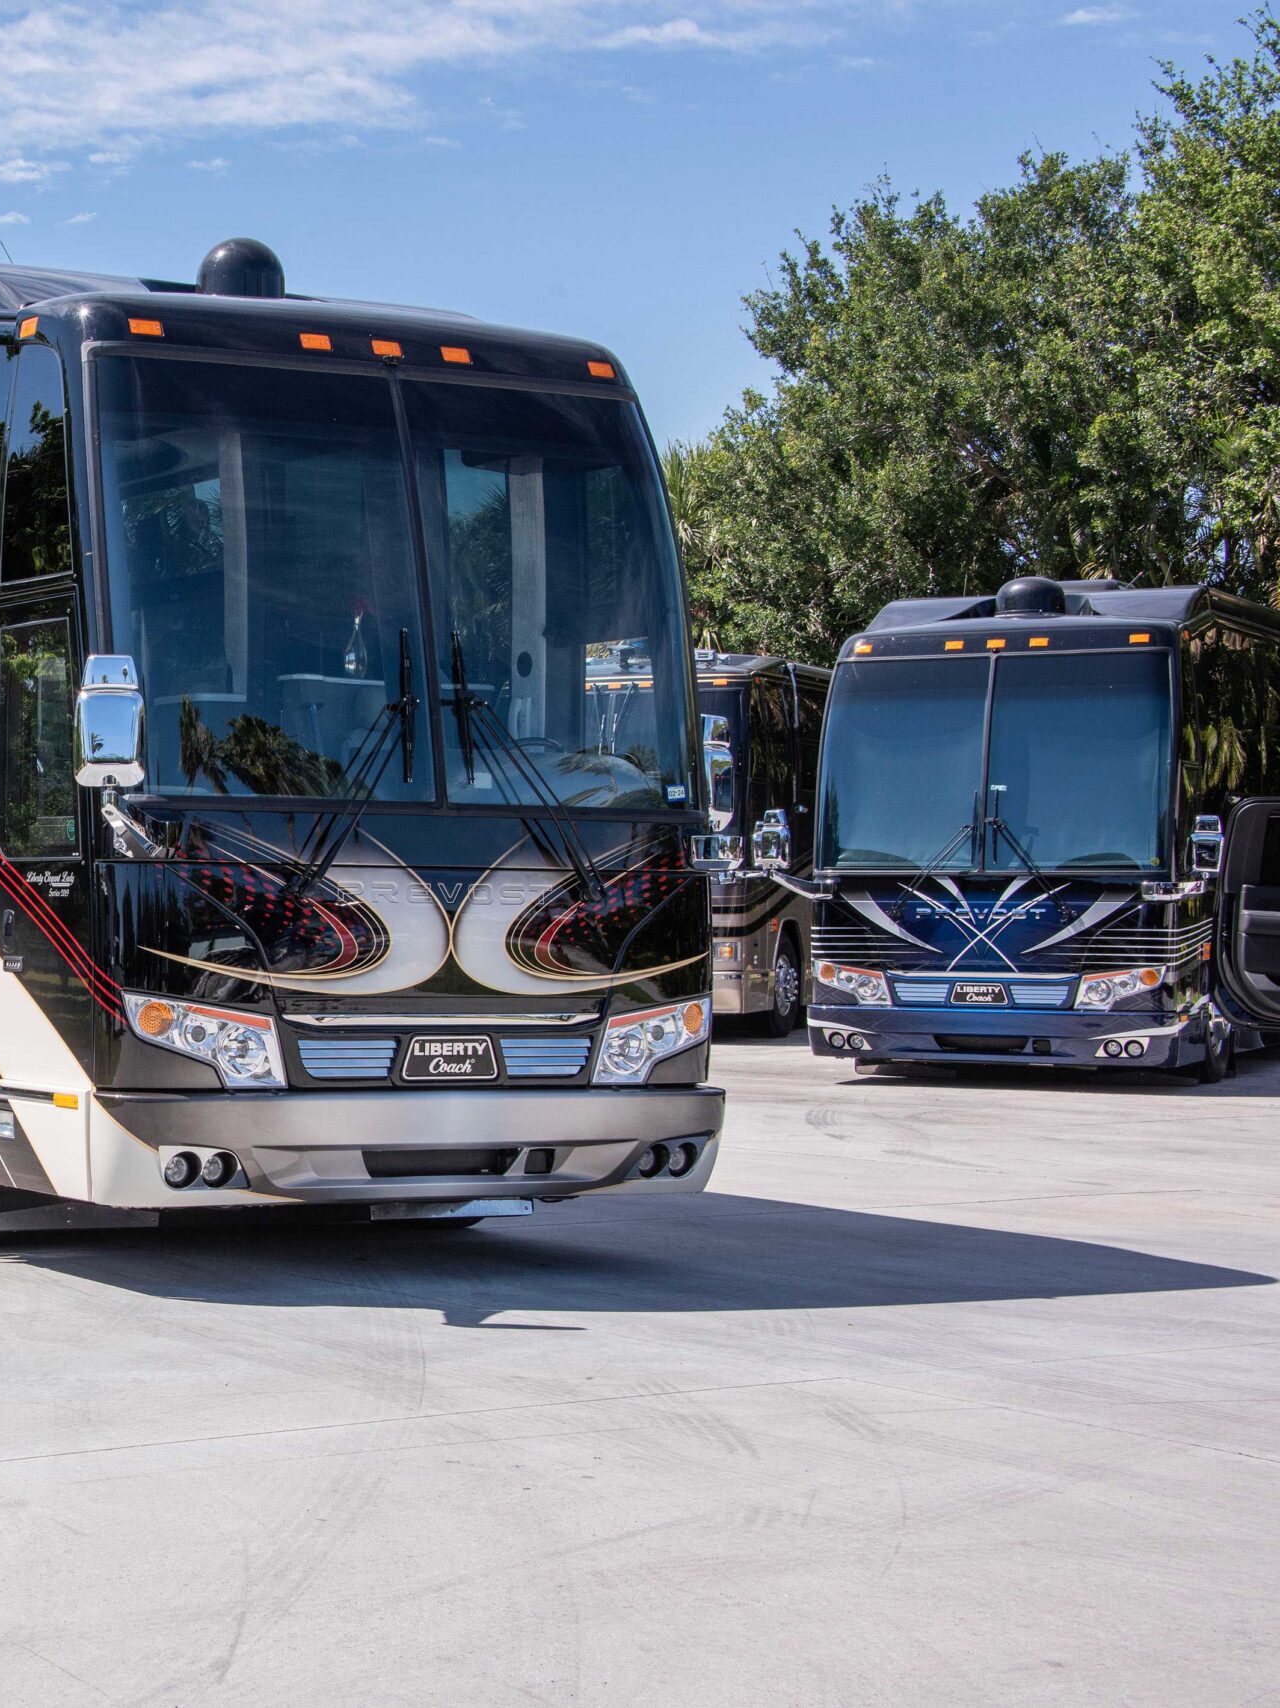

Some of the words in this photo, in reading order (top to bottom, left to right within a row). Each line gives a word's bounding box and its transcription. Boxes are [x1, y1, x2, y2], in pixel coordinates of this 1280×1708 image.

[337, 880, 553, 905] PREVOST
[916, 907, 1046, 919] PREVOST
[956, 985, 1000, 993] LIBERTY
[413, 1042, 487, 1056] LIBERTY
